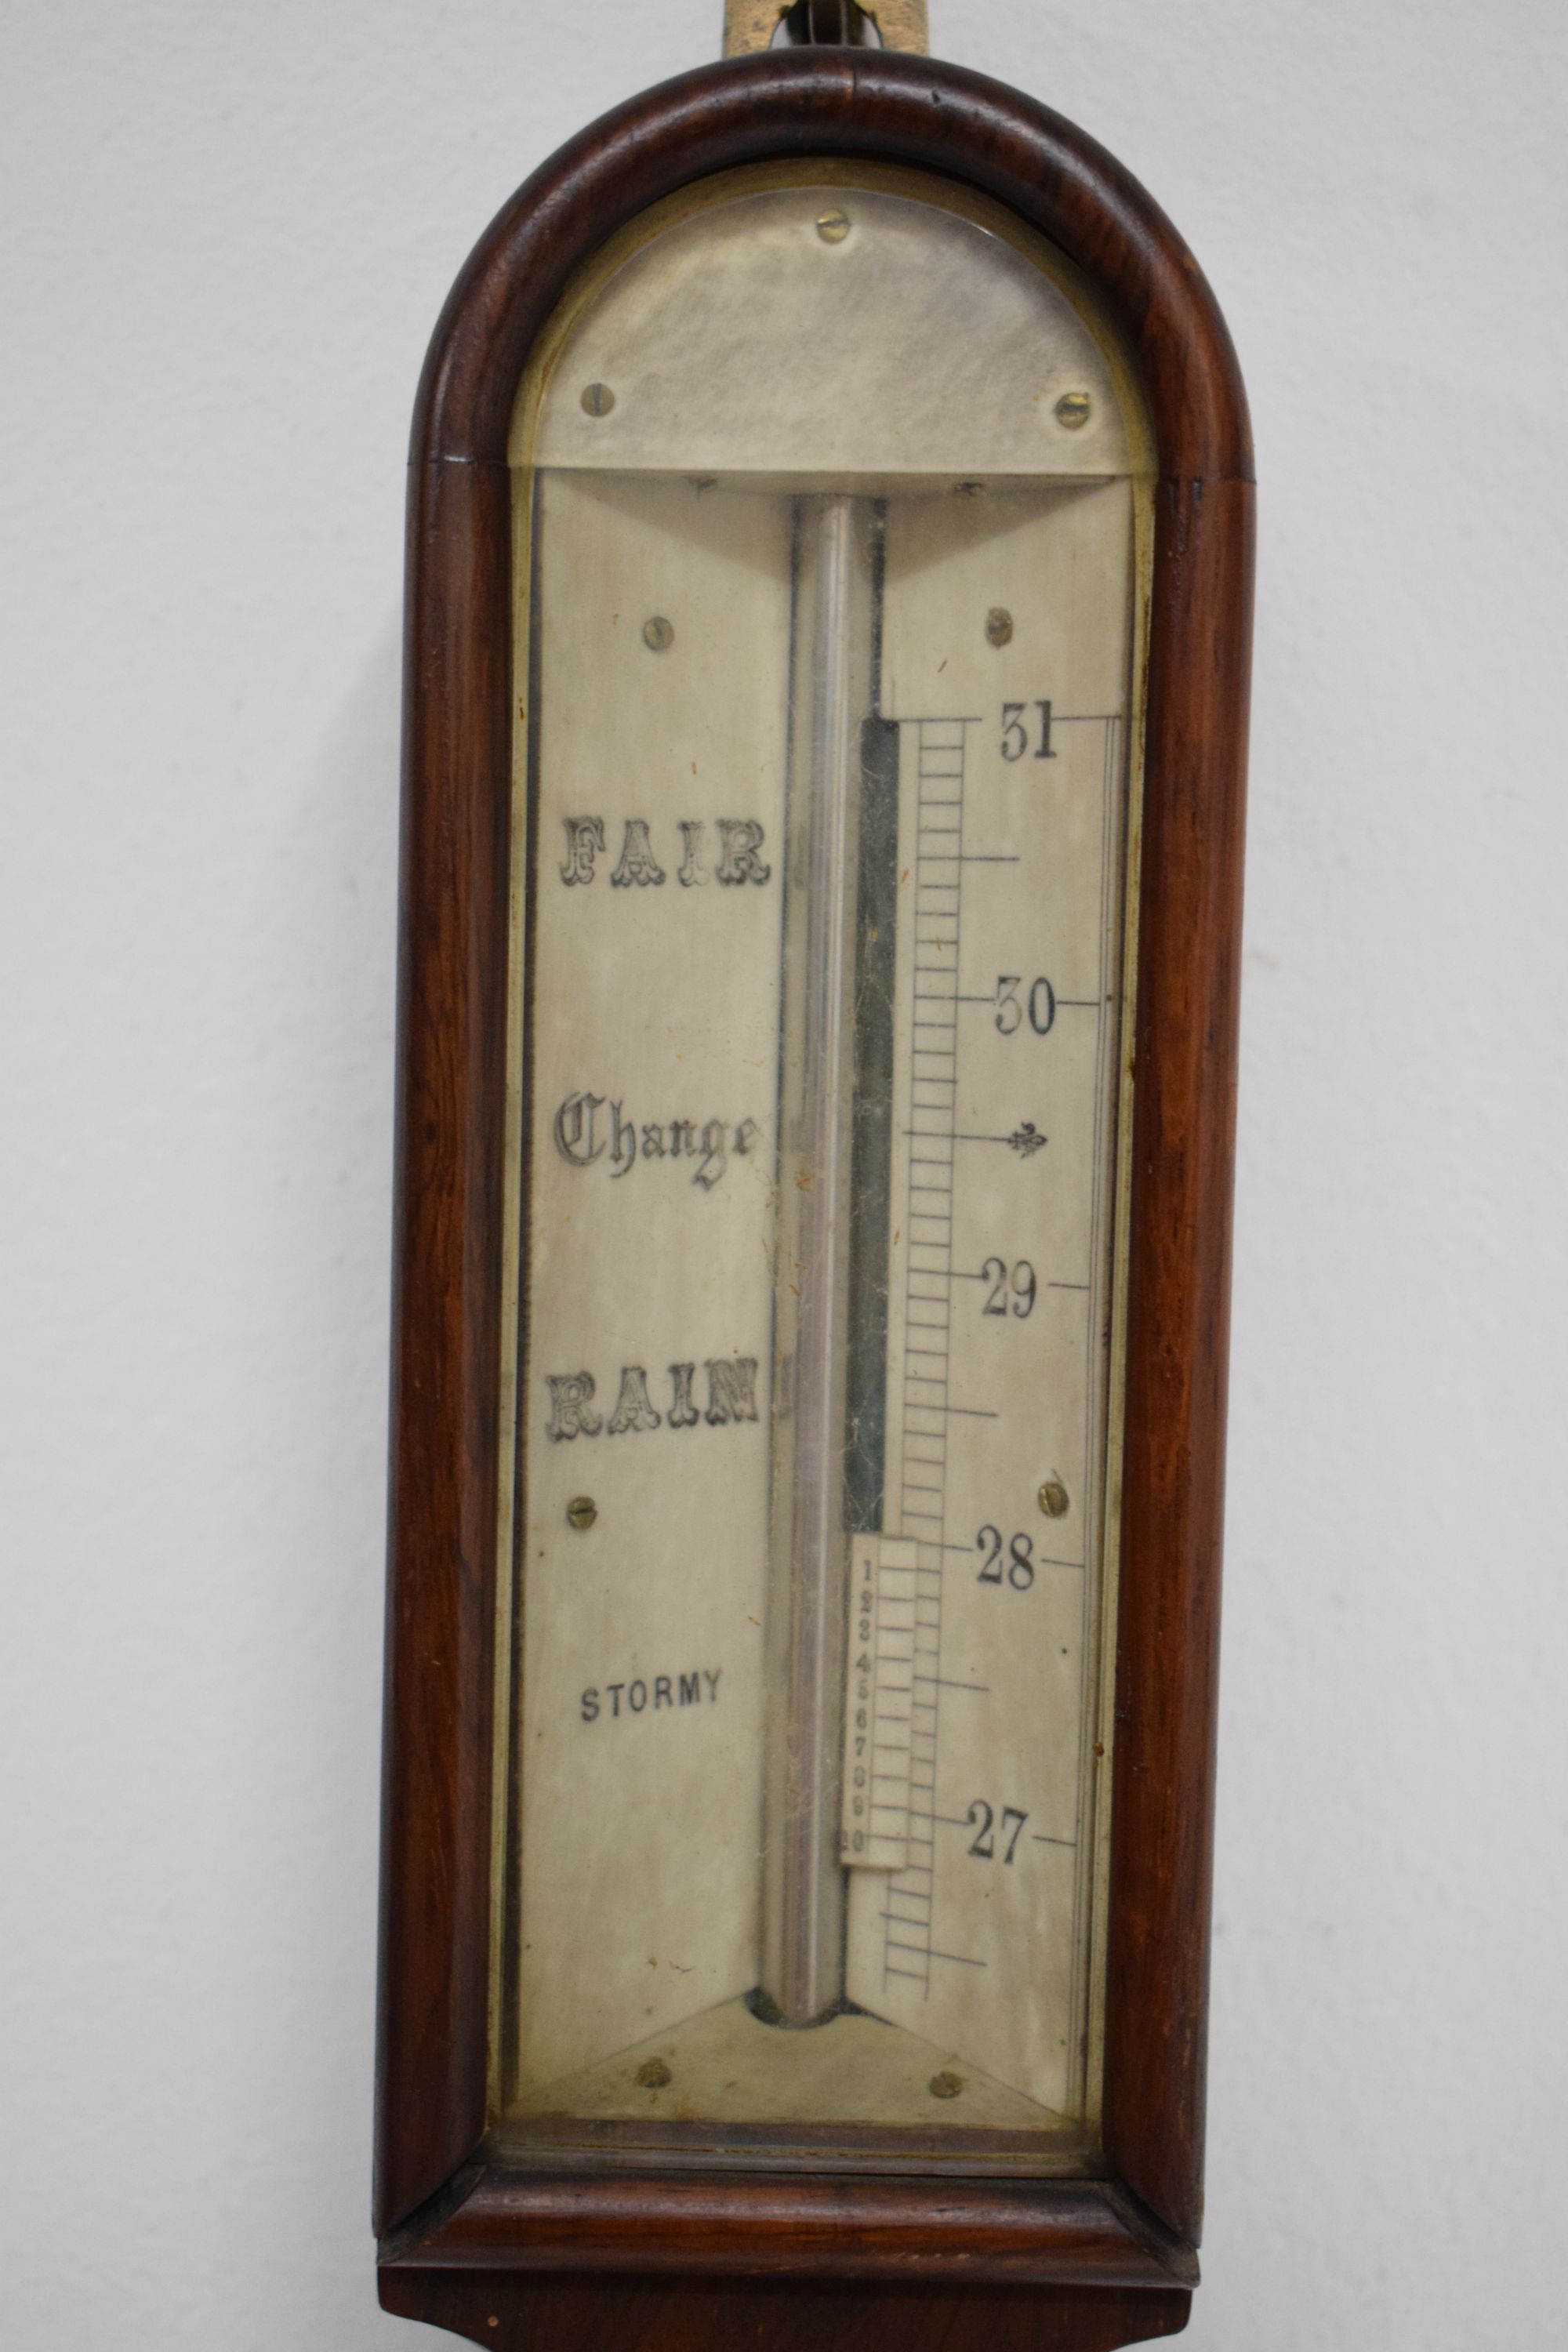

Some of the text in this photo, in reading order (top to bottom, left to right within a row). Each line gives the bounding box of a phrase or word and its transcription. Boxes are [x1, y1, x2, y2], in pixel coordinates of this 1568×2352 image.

[1000, 700, 1057, 762] 31
[561, 815, 771, 887] FAIR
[995, 975, 1055, 1036] 30
[554, 1091, 757, 1192] Change
[982, 1256, 1036, 1319] 29
[546, 1357, 758, 1442] RAIN
[976, 1525, 1034, 1591] 28
[856, 1651, 871, 1673] 4
[581, 1669, 721, 1722] STORMY
[855, 1736, 866, 1757] 7
[967, 1799, 1029, 1865] 27
